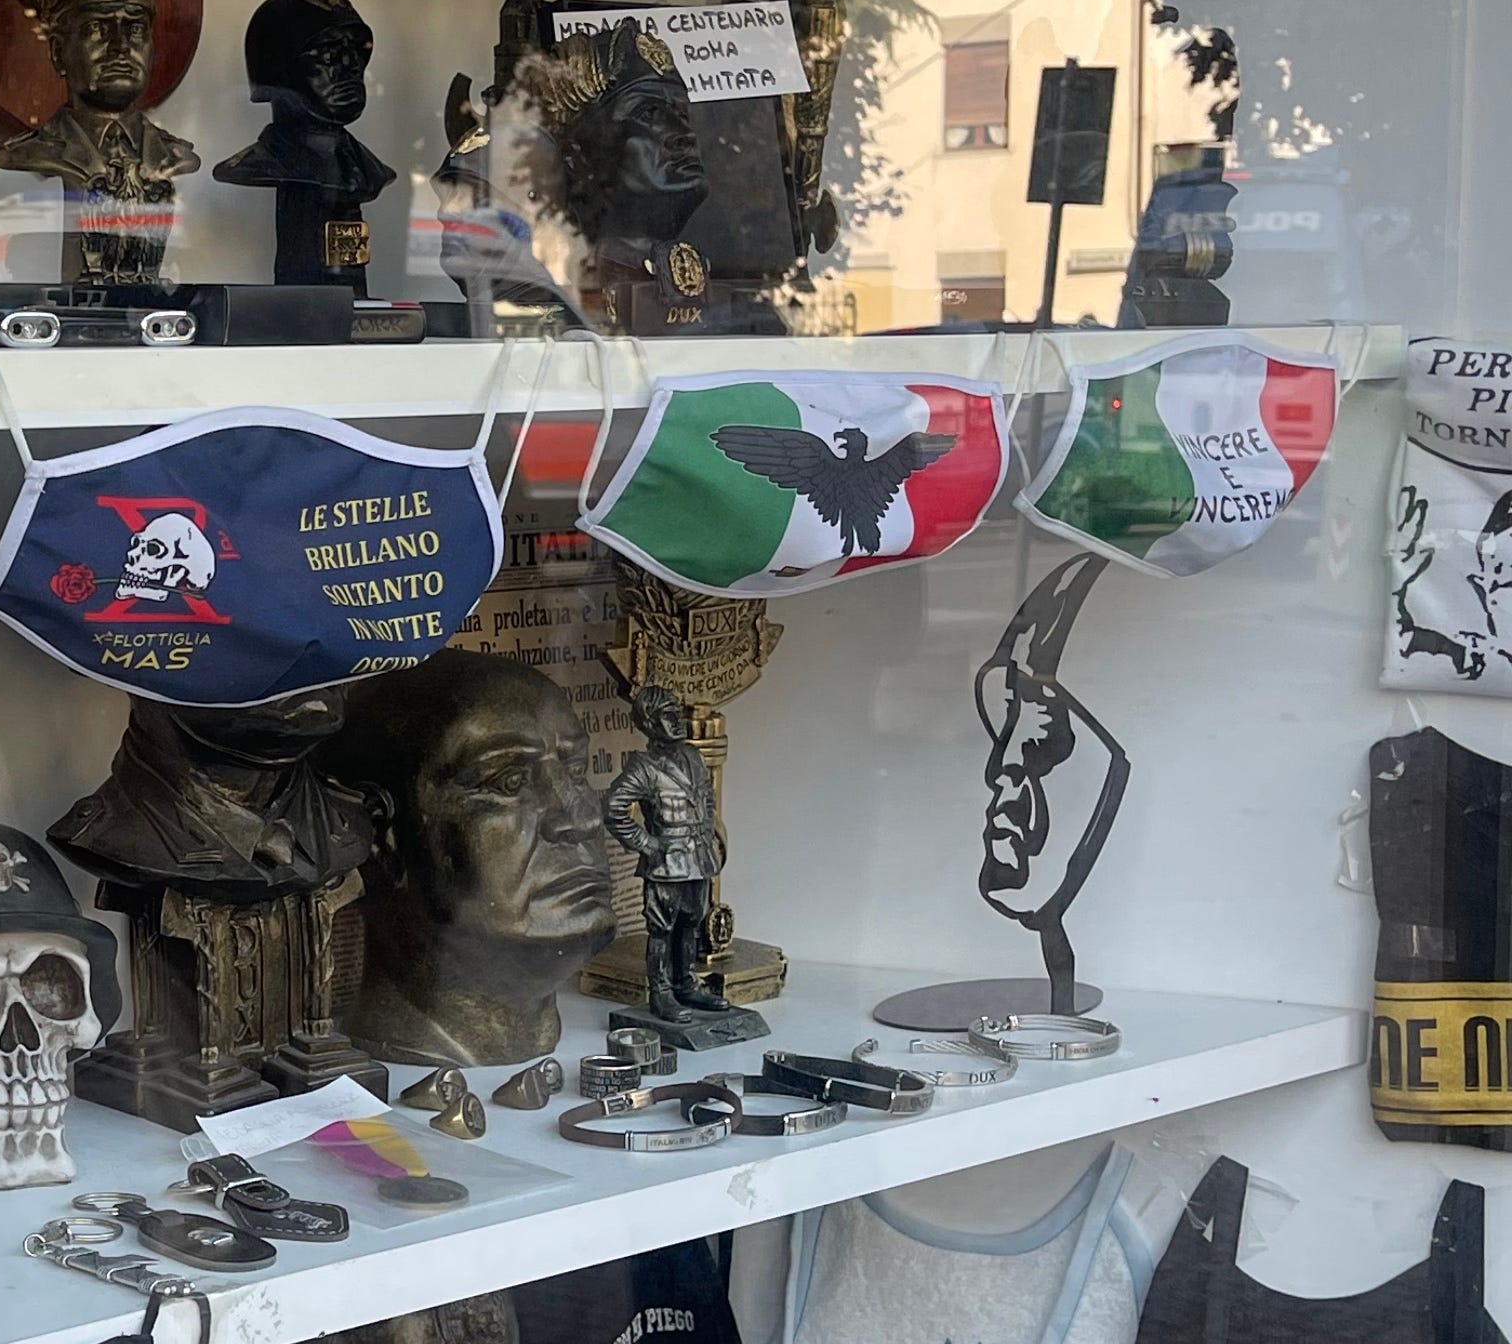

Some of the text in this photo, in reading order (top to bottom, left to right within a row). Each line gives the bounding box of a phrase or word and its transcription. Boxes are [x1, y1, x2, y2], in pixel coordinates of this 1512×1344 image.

[667, 7, 785, 34] CENTENARIO
[684, 40, 739, 63] ROMA
[666, 306, 704, 325] DUX
[1173, 428, 1268, 461] VINCERE
[1220, 467, 1243, 490] E
[299, 490, 431, 532] LE STELLE
[304, 530, 439, 571] BRILLANO
[322, 571, 444, 607] SOLTANTO
[346, 611, 444, 642] IN NOTTE
[693, 609, 733, 635] DUX
[113, 632, 211, 648] FLOTTIGLIA
[101, 647, 193, 670] MAS
[593, 748, 614, 776] alle
[644, 1307, 696, 1335] PIEGO
